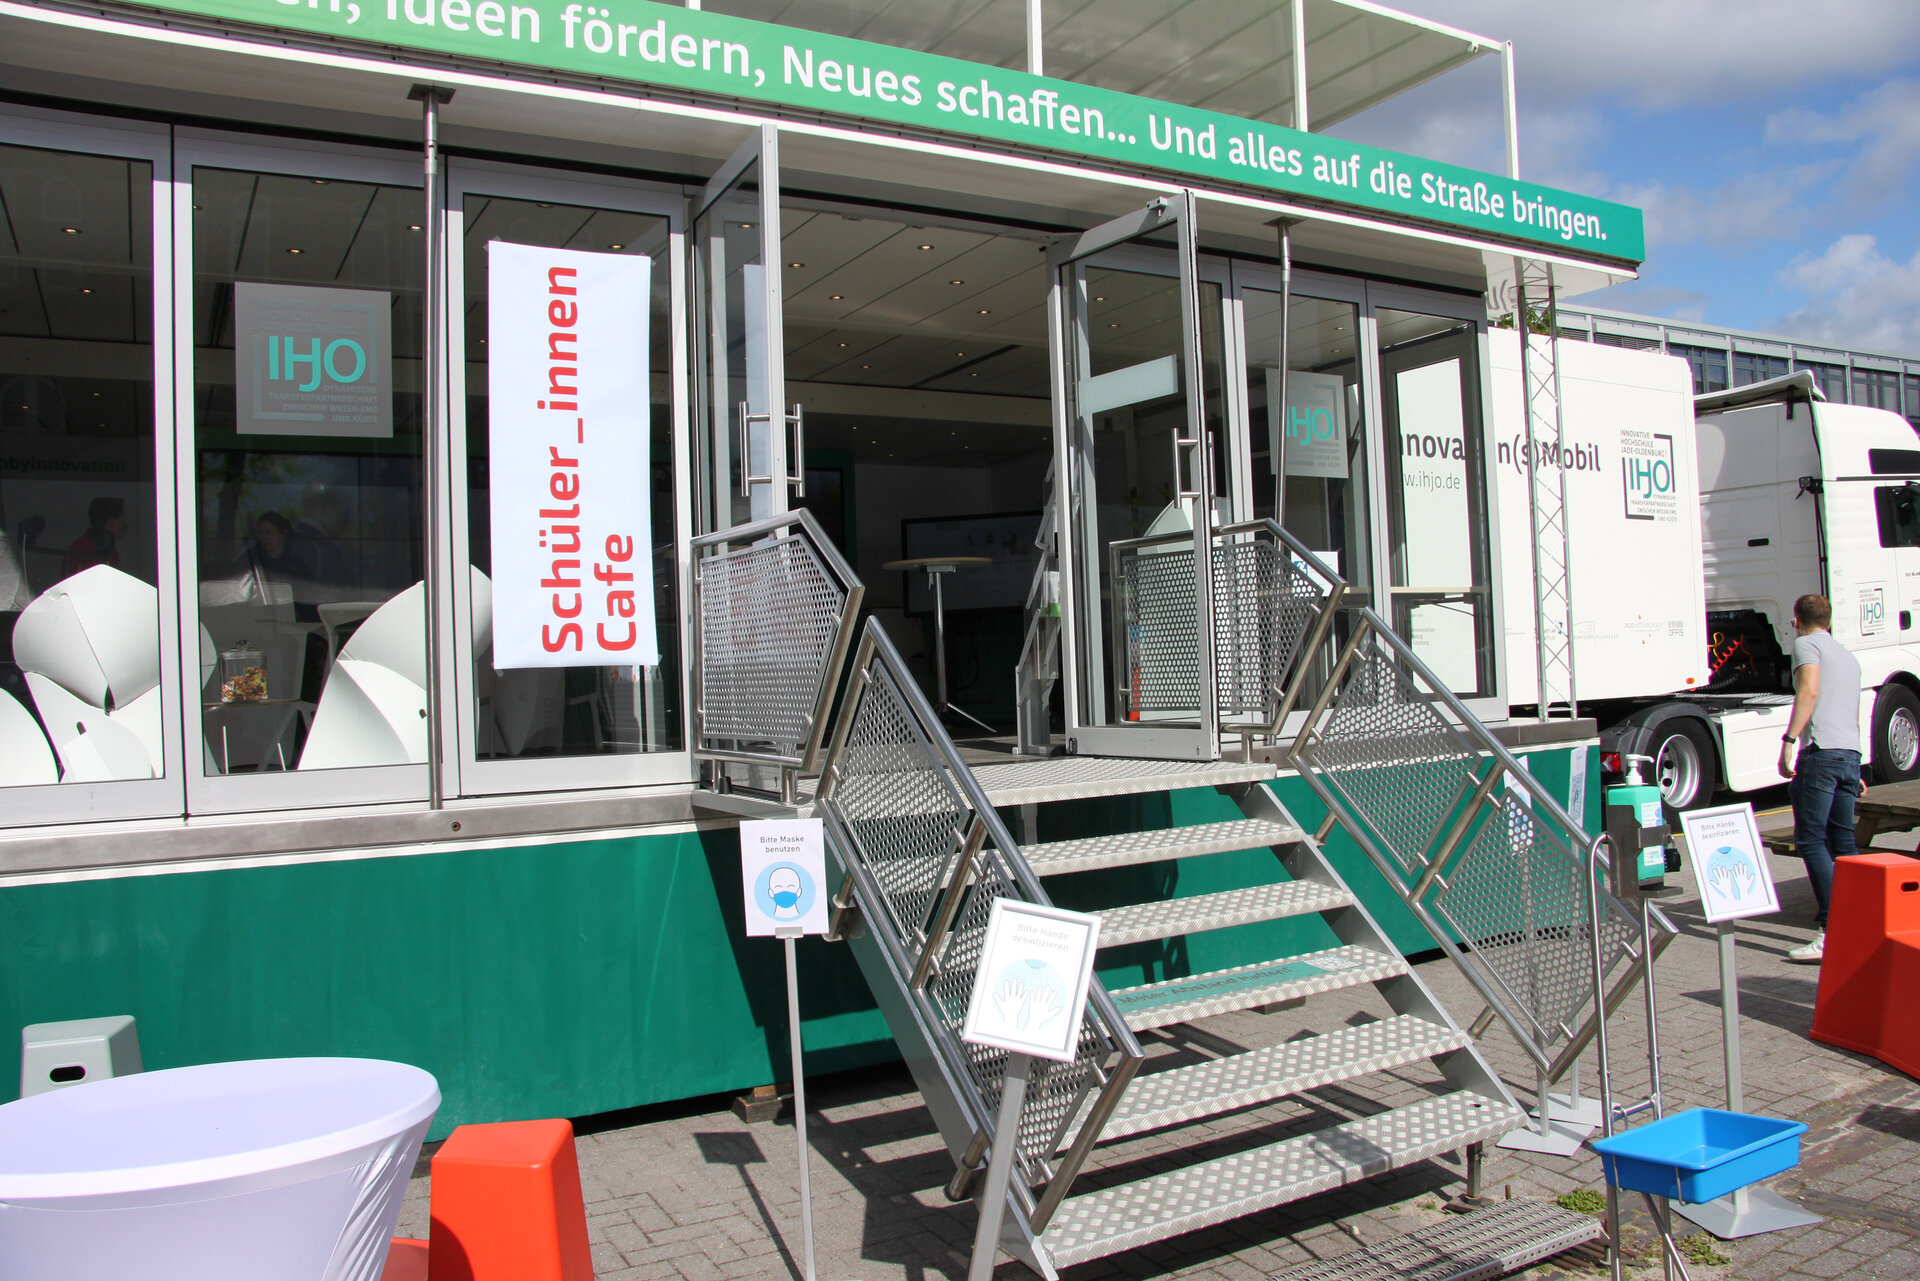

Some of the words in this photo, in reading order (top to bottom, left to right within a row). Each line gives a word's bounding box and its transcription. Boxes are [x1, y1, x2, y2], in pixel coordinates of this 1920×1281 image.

[560, 3, 766, 87] fördern,
[783, 45, 922, 106] Neues
[936, 79, 1137, 145] schaffen...
[1149, 114, 1217, 160] Und
[1228, 132, 1303, 176] alles
[1312, 154, 1361, 188] auf
[1370, 161, 1412, 198] die
[1421, 172, 1505, 218] Straße
[1512, 190, 1608, 241] bringen.
[537, 266, 584, 653] Schüler_innen
[1404, 470, 1461, 492] w.ihjo.de
[594, 533, 637, 652] Cafe
[759, 836, 778, 844] Bitte
[780, 835, 804, 843] Maske
[765, 845, 801, 853] benutzen
[1016, 922, 1038, 935] Bitte
